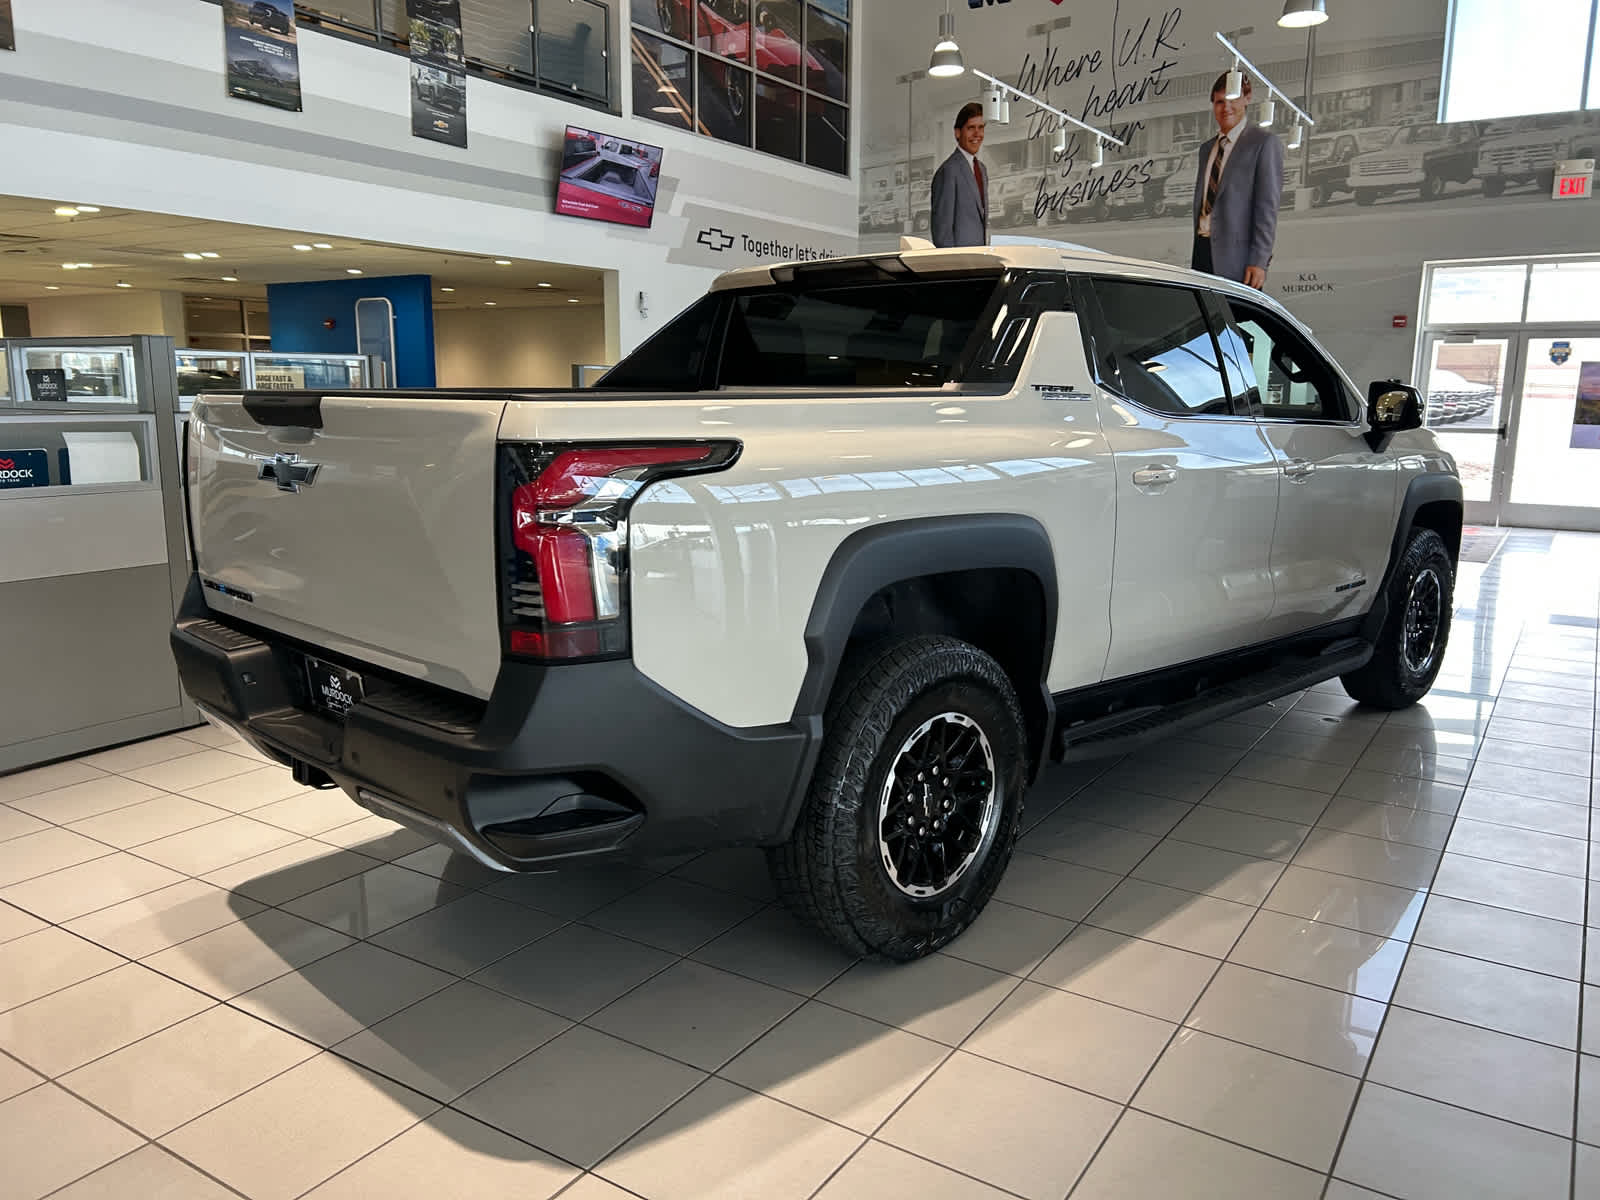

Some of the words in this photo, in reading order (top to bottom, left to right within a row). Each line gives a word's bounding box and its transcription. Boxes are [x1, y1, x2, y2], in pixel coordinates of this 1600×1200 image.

[1014, 47, 1102, 101] Where
[1081, 61, 1178, 122] heart
[1053, 134, 1080, 178] of
[1034, 160, 1154, 220] business
[1559, 177, 1587, 195] EXIT
[741, 234, 794, 259] Together
[795, 243, 817, 261] let's
[1281, 283, 1335, 293] MURDOCK
[321, 684, 353, 705] MURDOCK
